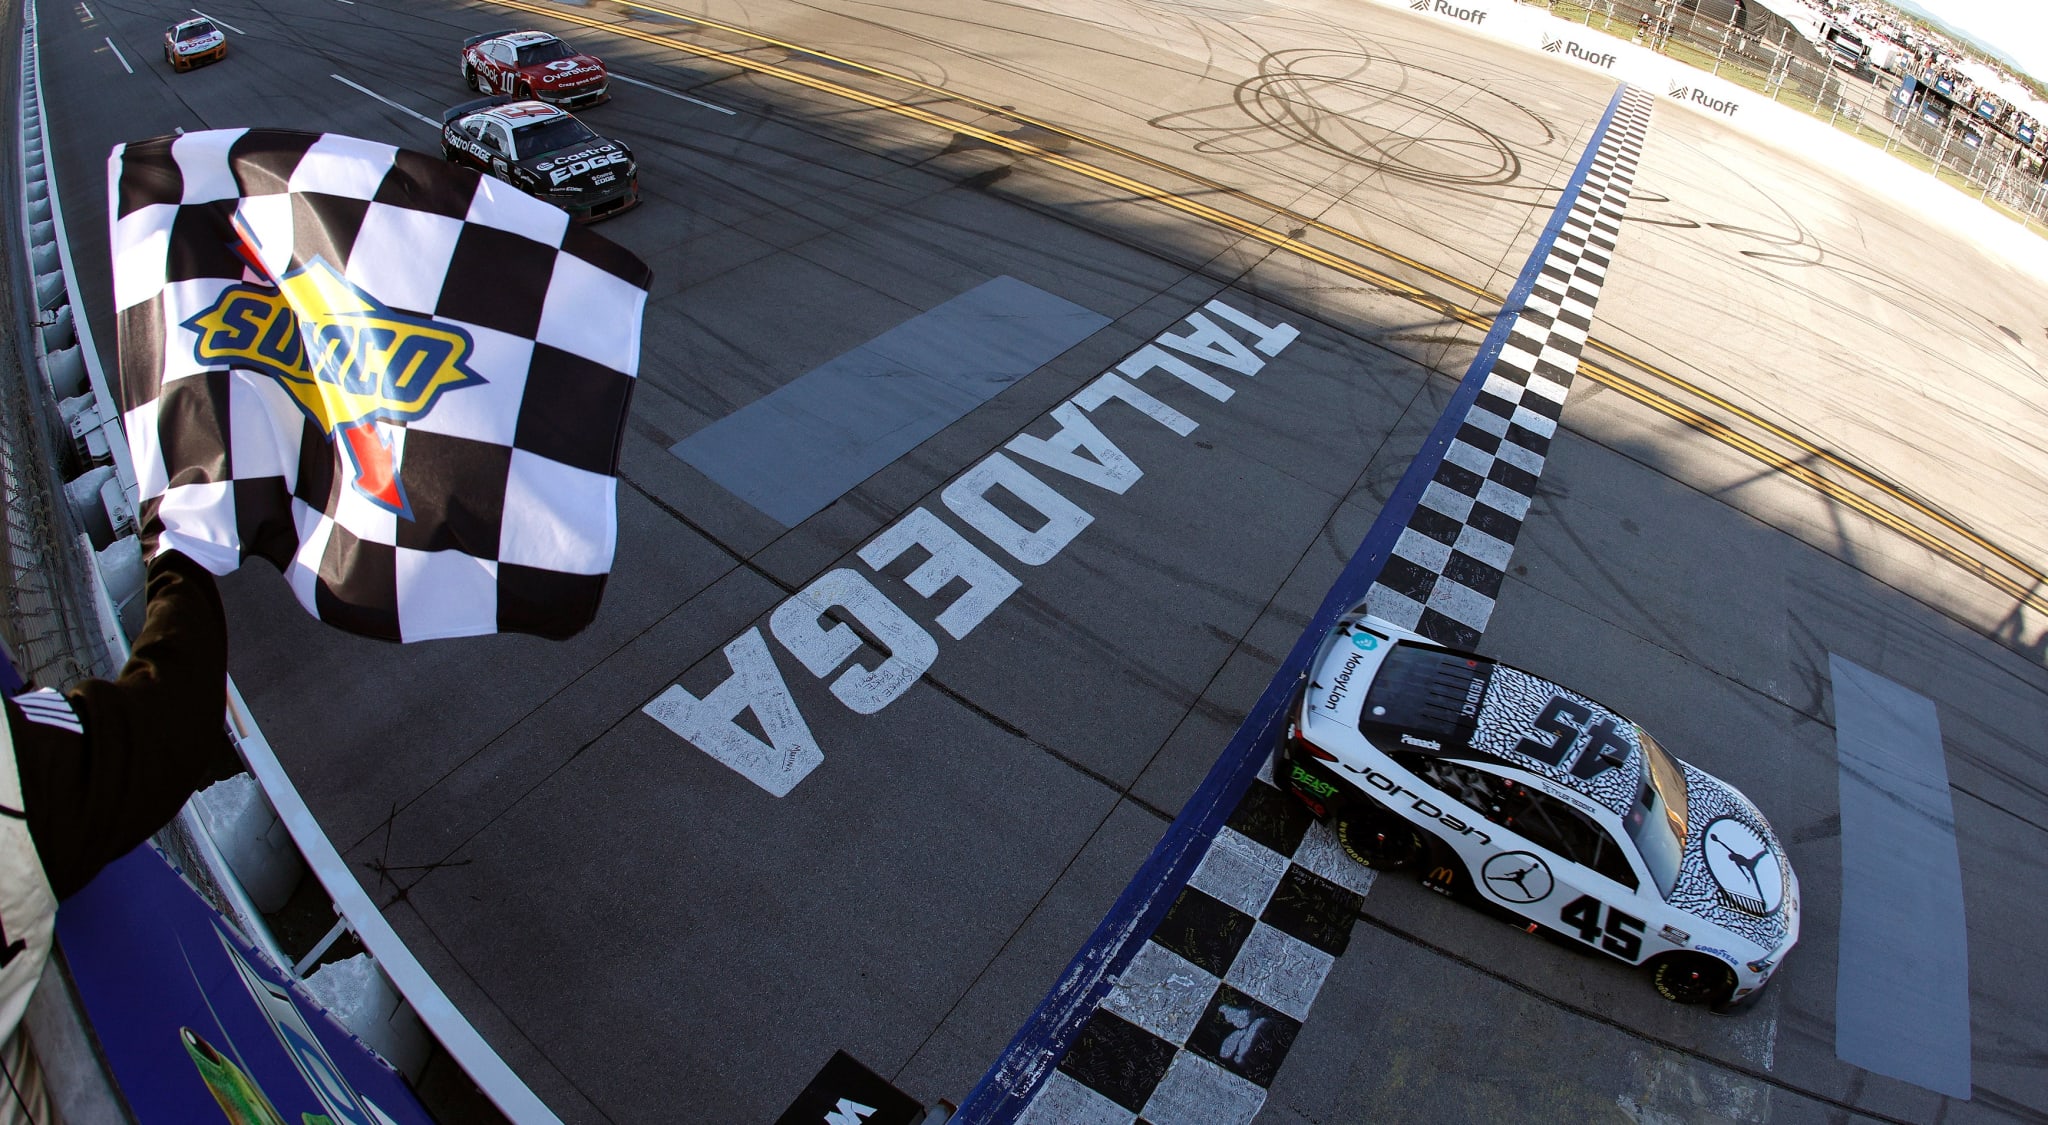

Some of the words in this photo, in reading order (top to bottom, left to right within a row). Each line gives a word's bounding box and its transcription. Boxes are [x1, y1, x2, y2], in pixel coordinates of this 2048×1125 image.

[1434, 0, 1487, 25] Ruoff
[1566, 41, 1616, 69] Ruoff
[501, 71, 514, 94] 10
[543, 64, 601, 83] Overstock
[1691, 88, 1739, 117] Ruoff
[448, 129, 470, 152] Castrol
[469, 143, 492, 163] EDGE
[554, 144, 616, 165] Castrol
[549, 150, 629, 187] EDGE
[209, 298, 454, 403] SUNOCO
[641, 299, 1301, 798] TALLADEGA
[1325, 652, 1364, 710] MoneyLion
[1513, 695, 1633, 781] 45
[1291, 766, 1339, 797] BEAST
[1560, 893, 1647, 962] 45
[1695, 944, 1739, 966] GOODYEAR
